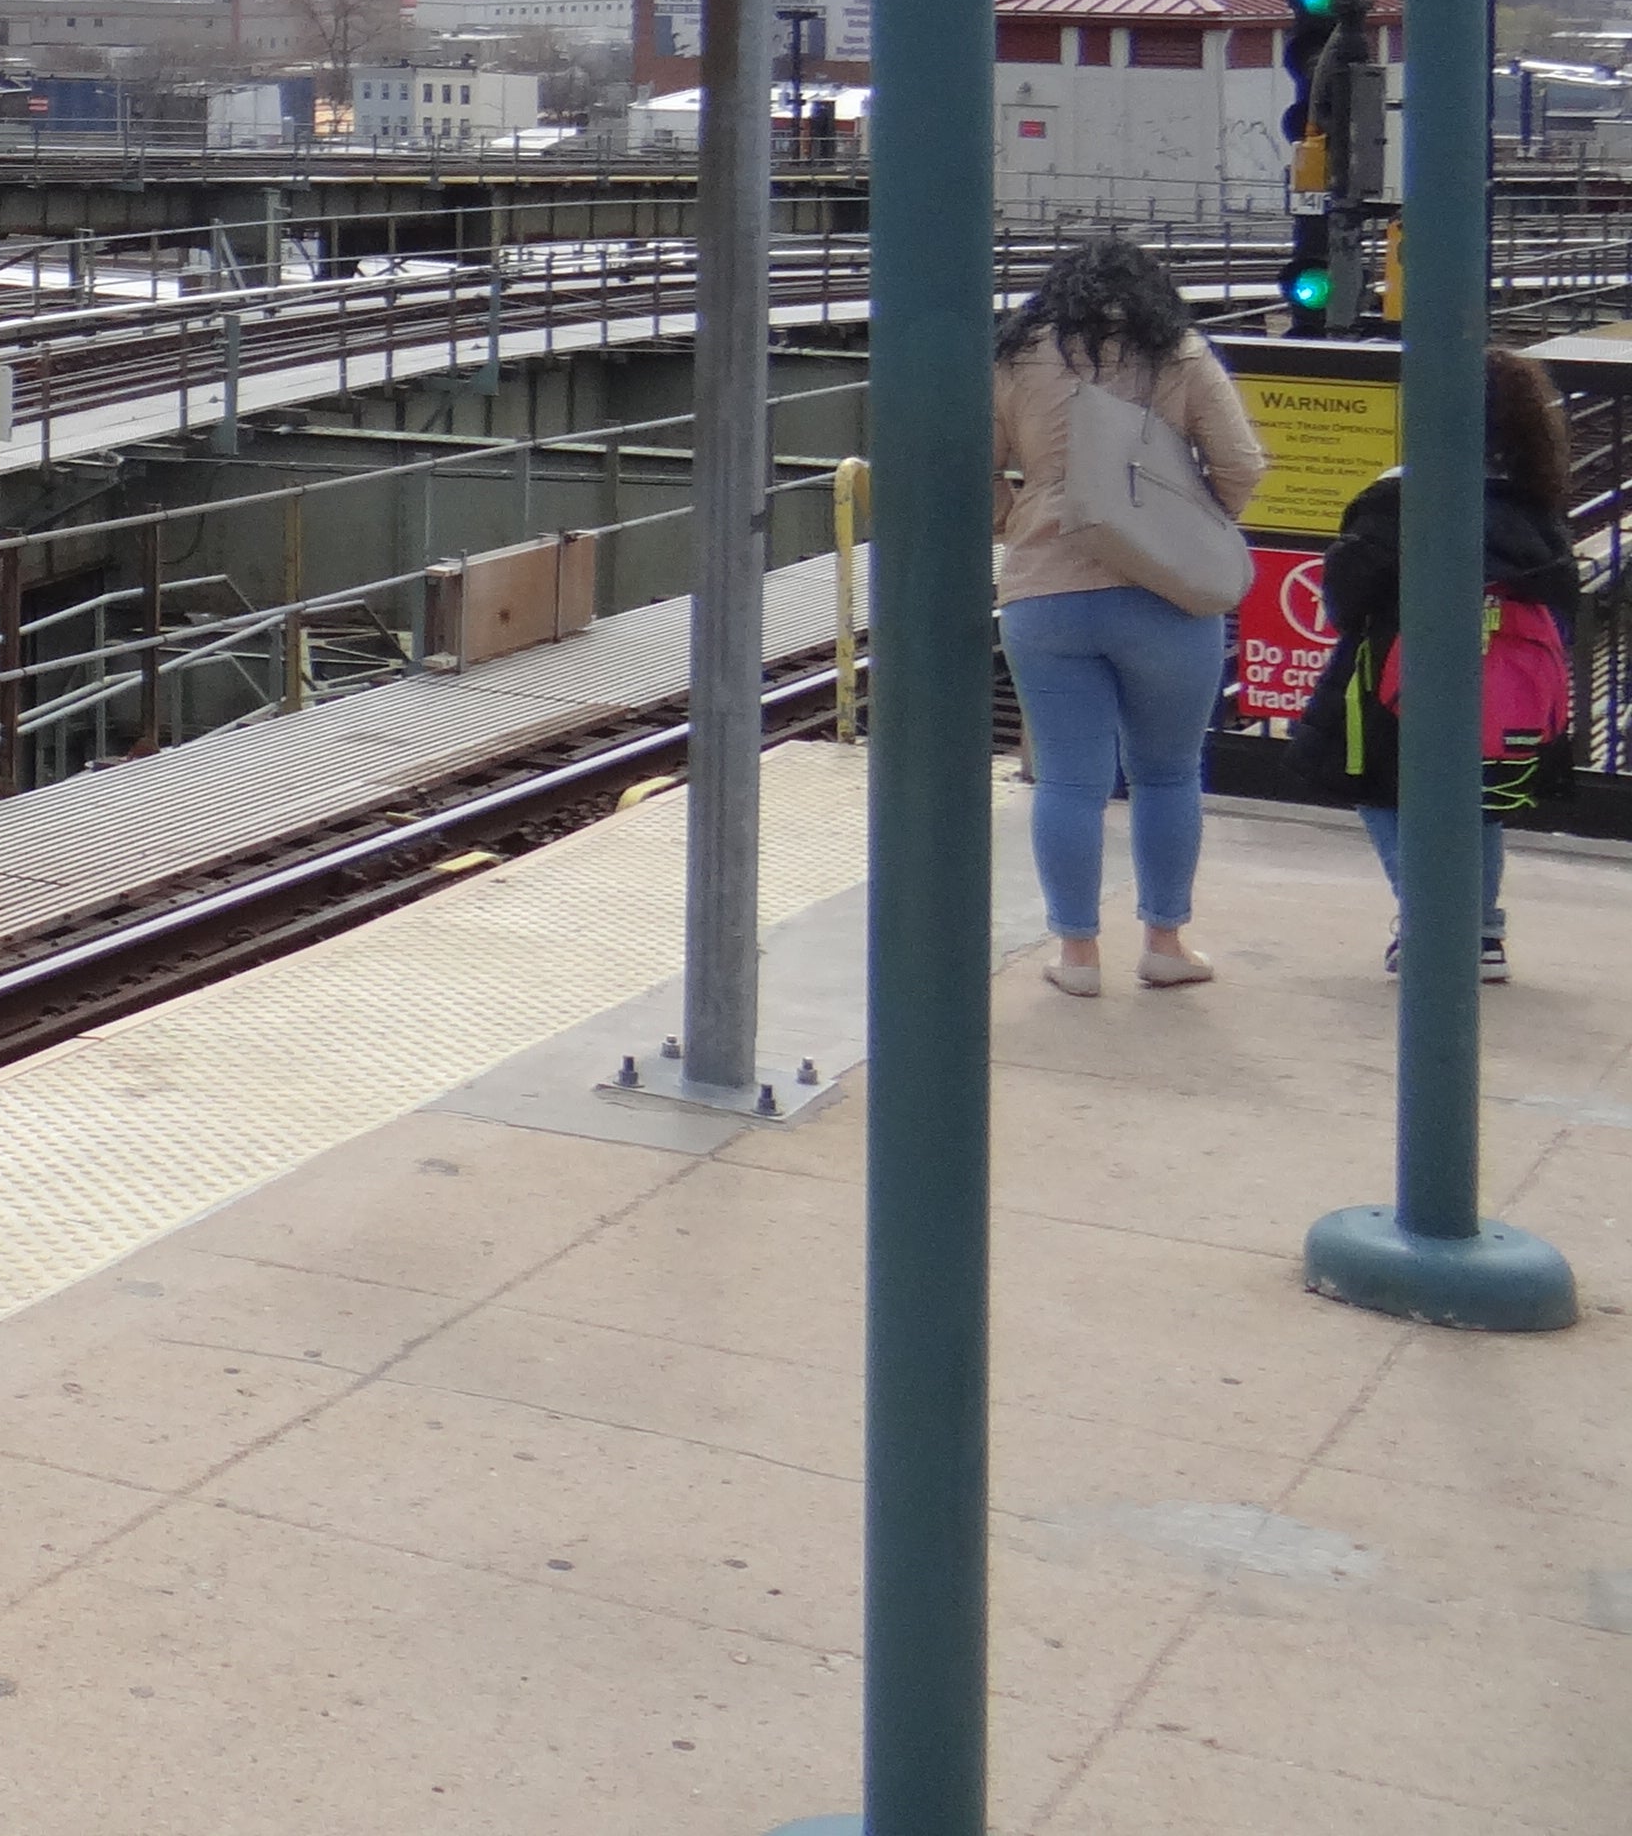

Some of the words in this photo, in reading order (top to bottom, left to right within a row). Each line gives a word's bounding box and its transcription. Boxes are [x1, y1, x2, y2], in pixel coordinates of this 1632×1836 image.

[1260, 392, 1367, 414] WARNING
[1245, 639, 1283, 664] Do
[1246, 664, 1275, 683] or
[1247, 686, 1312, 711] track
